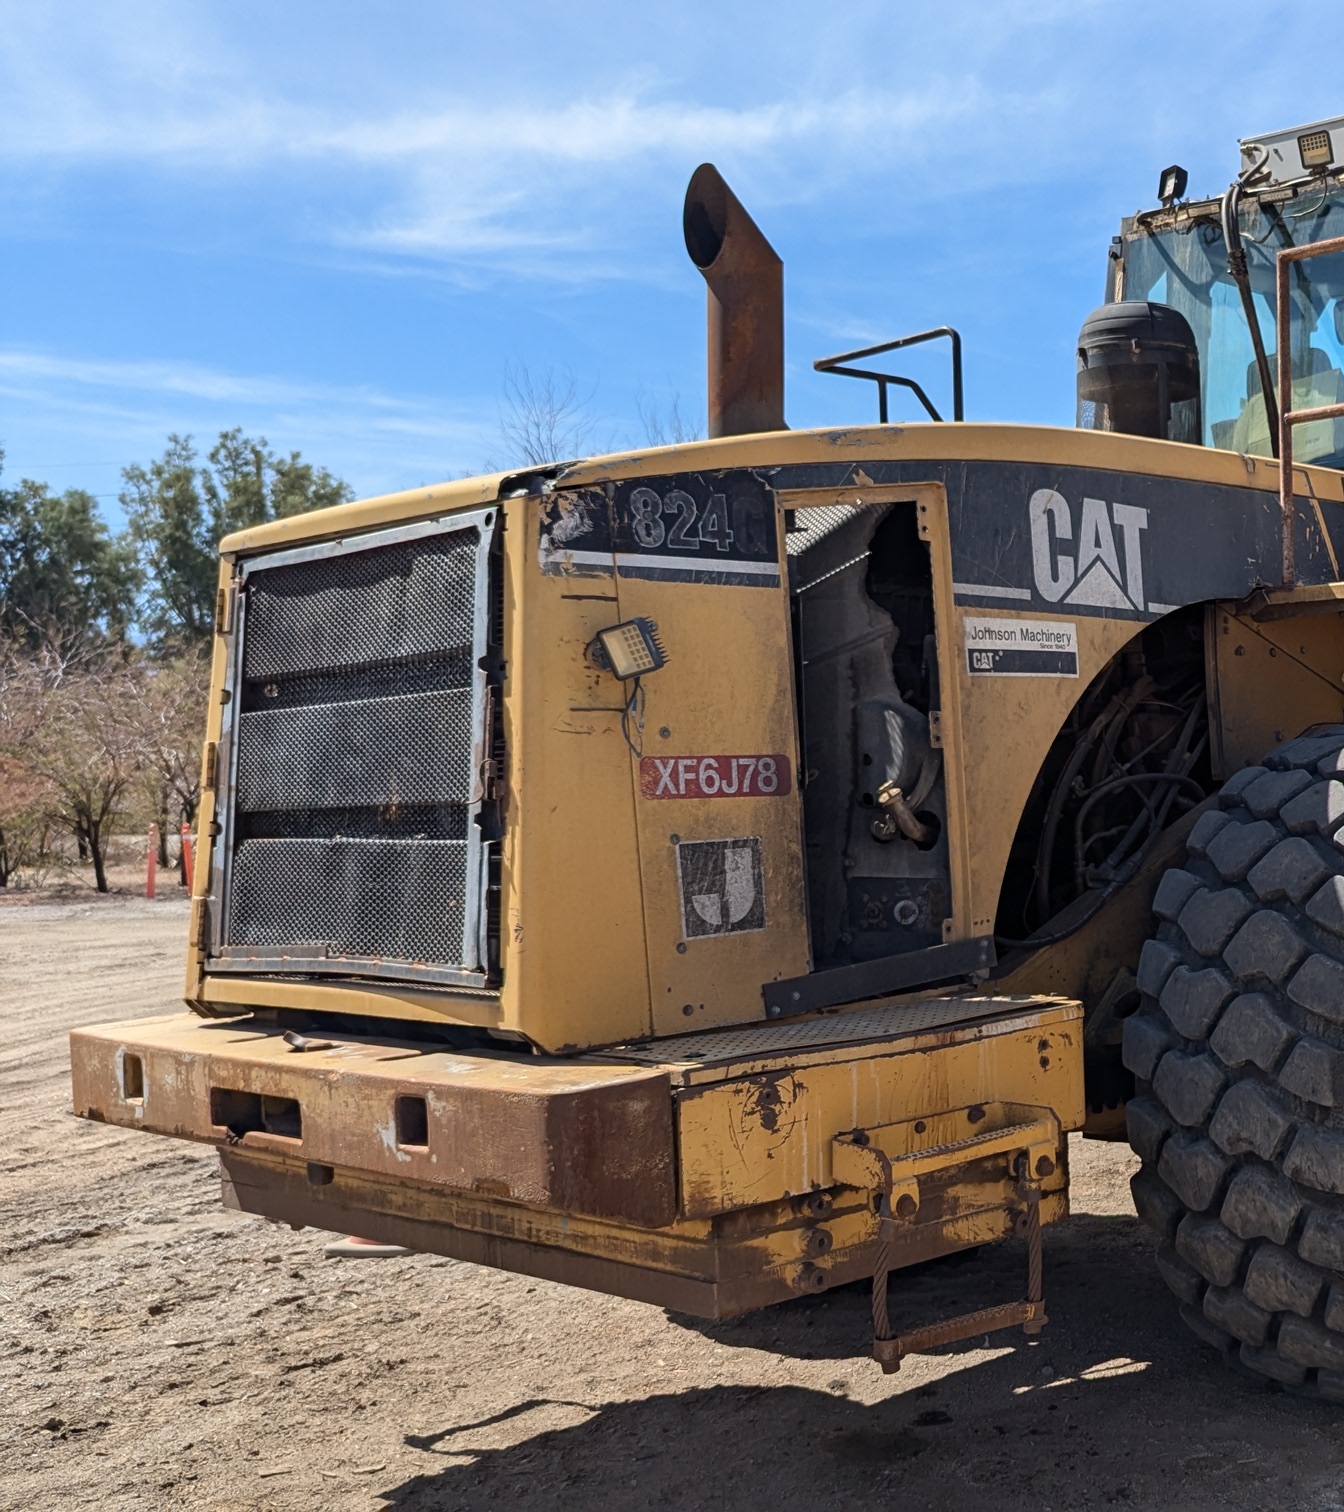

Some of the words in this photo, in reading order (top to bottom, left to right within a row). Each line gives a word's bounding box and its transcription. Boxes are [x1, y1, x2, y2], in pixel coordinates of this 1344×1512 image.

[1029, 488, 1150, 612] CAT
[971, 626, 1017, 641] Johnson
[1020, 628, 1072, 647] Machinery
[972, 651, 994, 669] CAT
[654, 757, 779, 795] XF6J78
